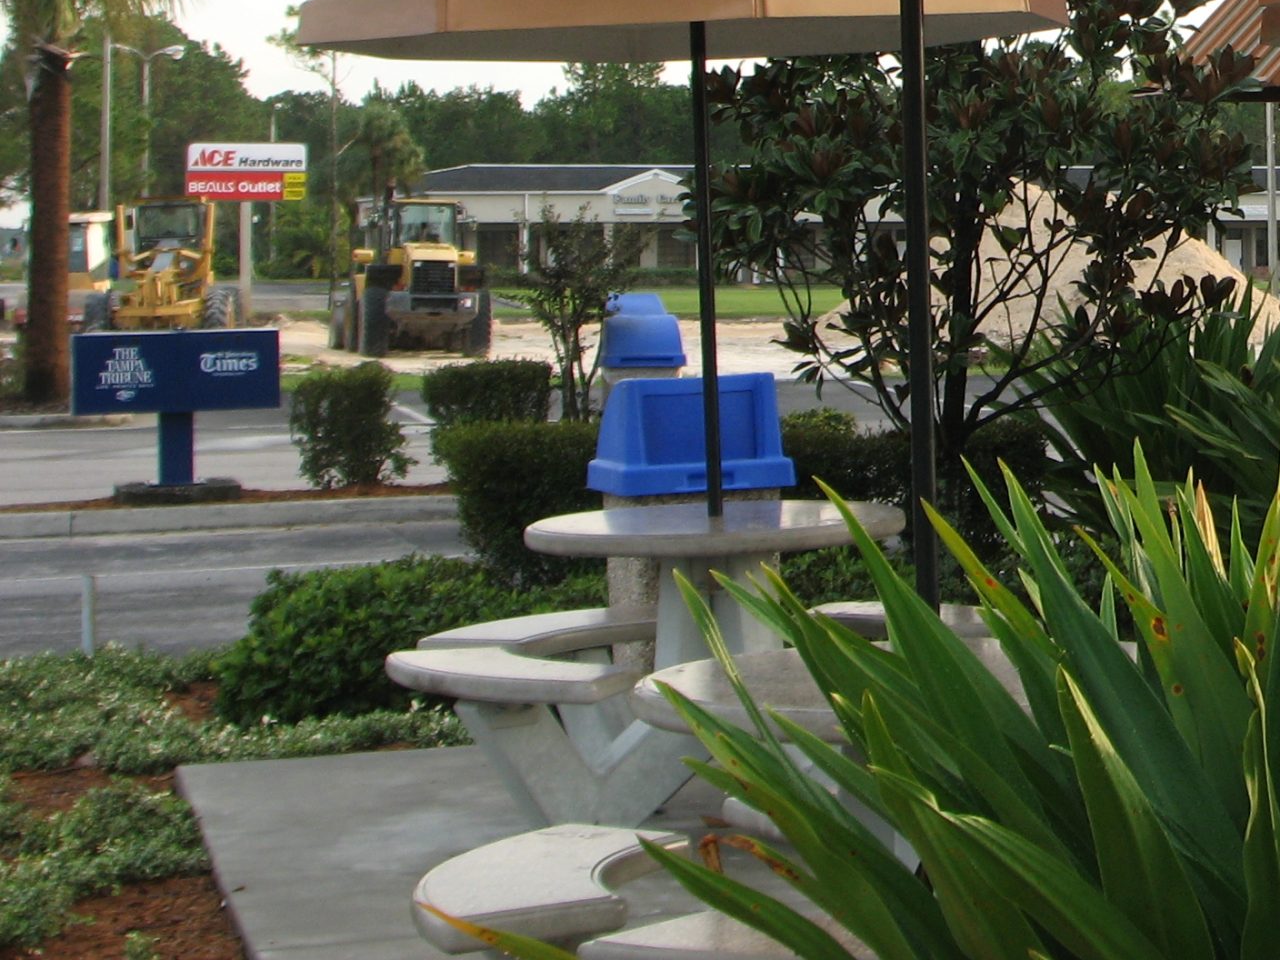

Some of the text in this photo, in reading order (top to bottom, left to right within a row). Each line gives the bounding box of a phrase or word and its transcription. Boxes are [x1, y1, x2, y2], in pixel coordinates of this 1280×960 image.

[192, 148, 303, 168] ACE Hardware
[188, 182, 234, 193] BEALLS
[238, 181, 280, 193] Outlet
[112, 347, 138, 360] THE
[105, 359, 144, 372] TAMPA
[200, 353, 257, 372] Times
[98, 371, 152, 384] TRIBUNE
